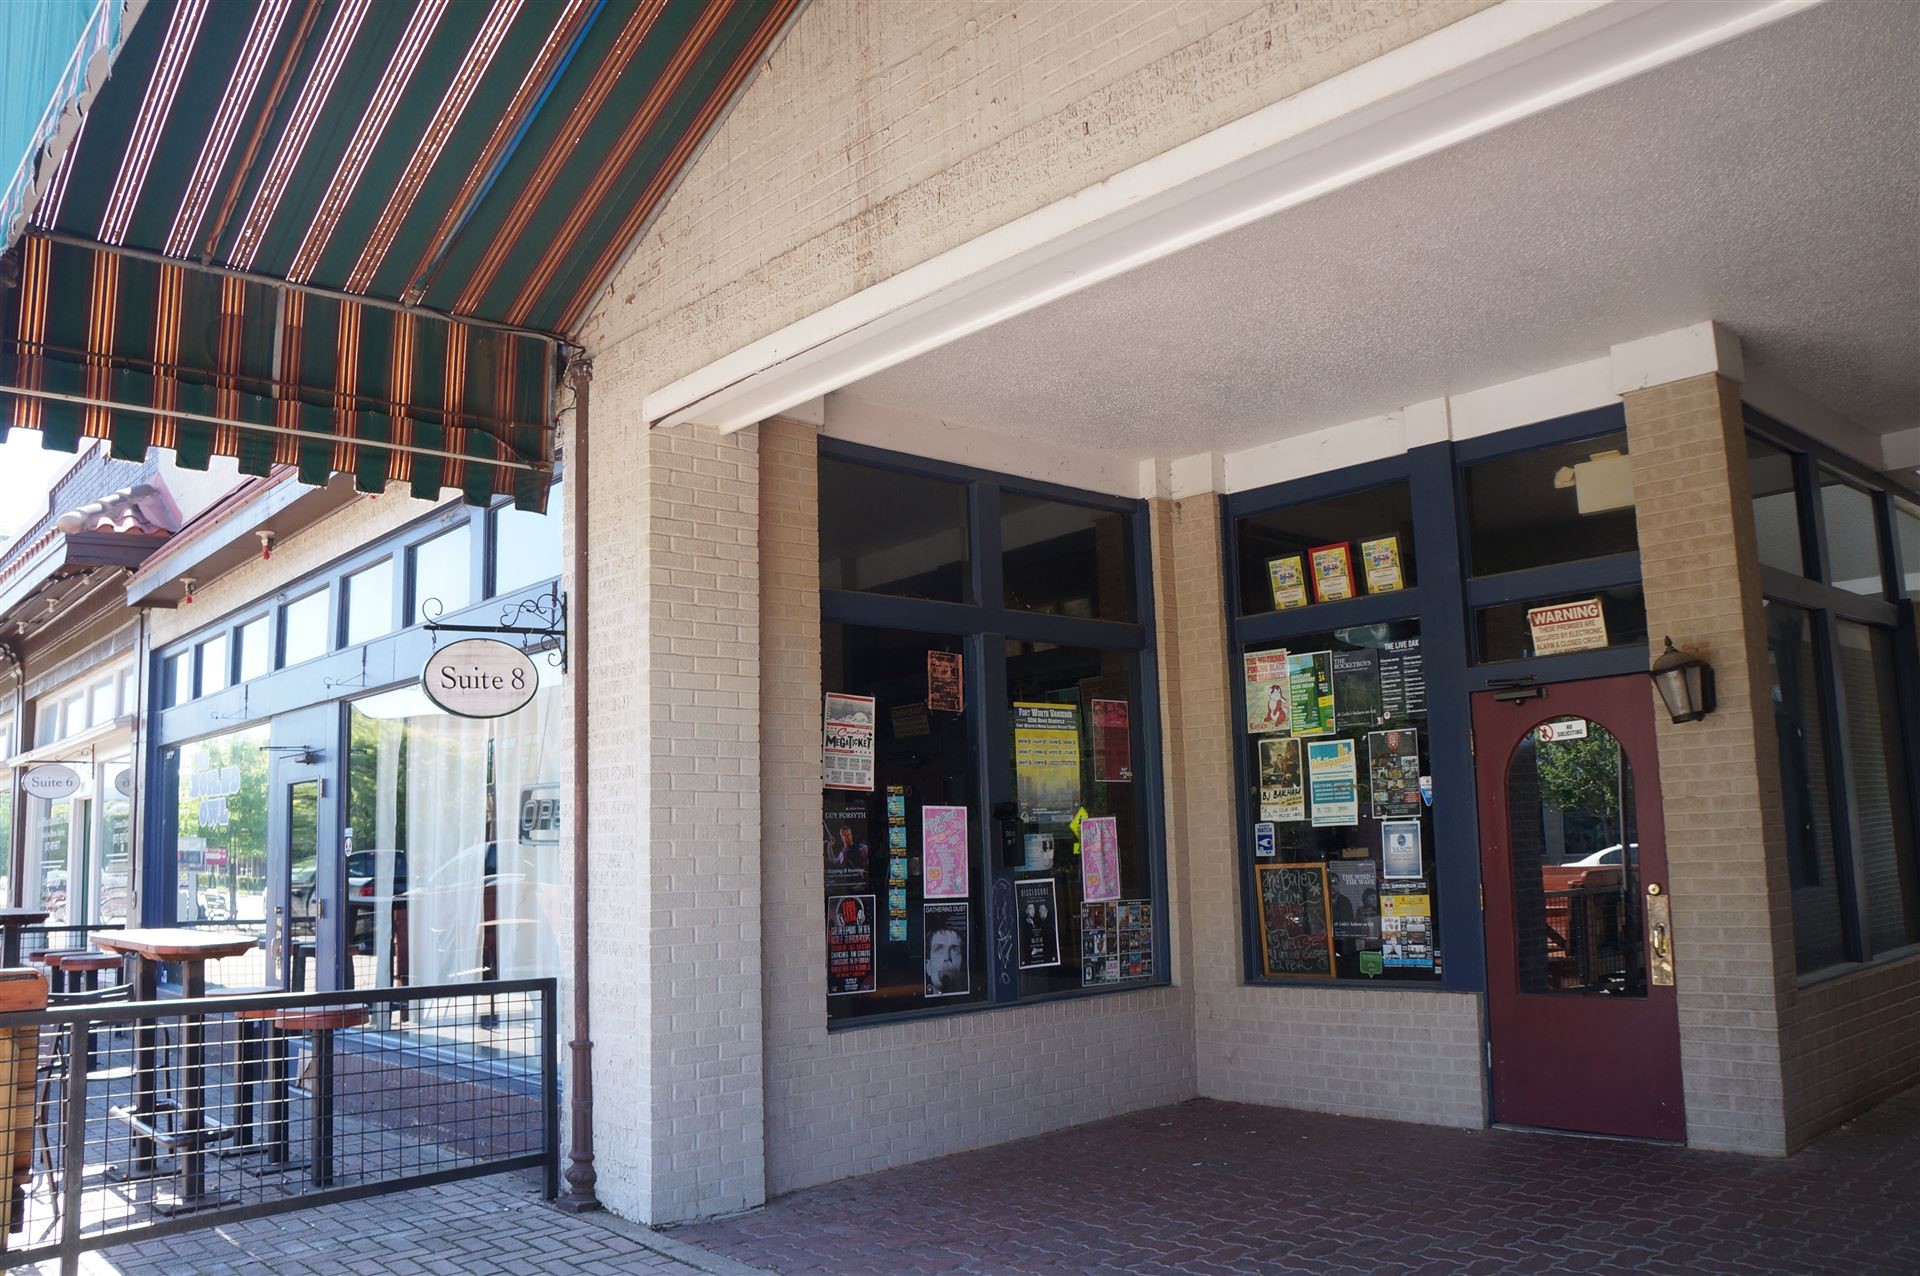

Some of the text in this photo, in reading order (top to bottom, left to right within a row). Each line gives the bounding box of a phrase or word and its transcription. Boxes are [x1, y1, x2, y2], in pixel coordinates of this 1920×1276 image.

[1534, 604, 1598, 624] WARNING
[1536, 634, 1560, 642] SECURED
[1569, 627, 1603, 637] ELECTRONIC
[1384, 639, 1420, 650] THE LIVE OAK
[1537, 641, 1554, 650] ALARM
[1561, 639, 1582, 647] CLOSED
[1583, 635, 1604, 644] CIRCUIT
[441, 666, 524, 690] Suite 8
[1557, 729, 1583, 737] SOLICITING
[31, 776, 74, 788] Suite 6
